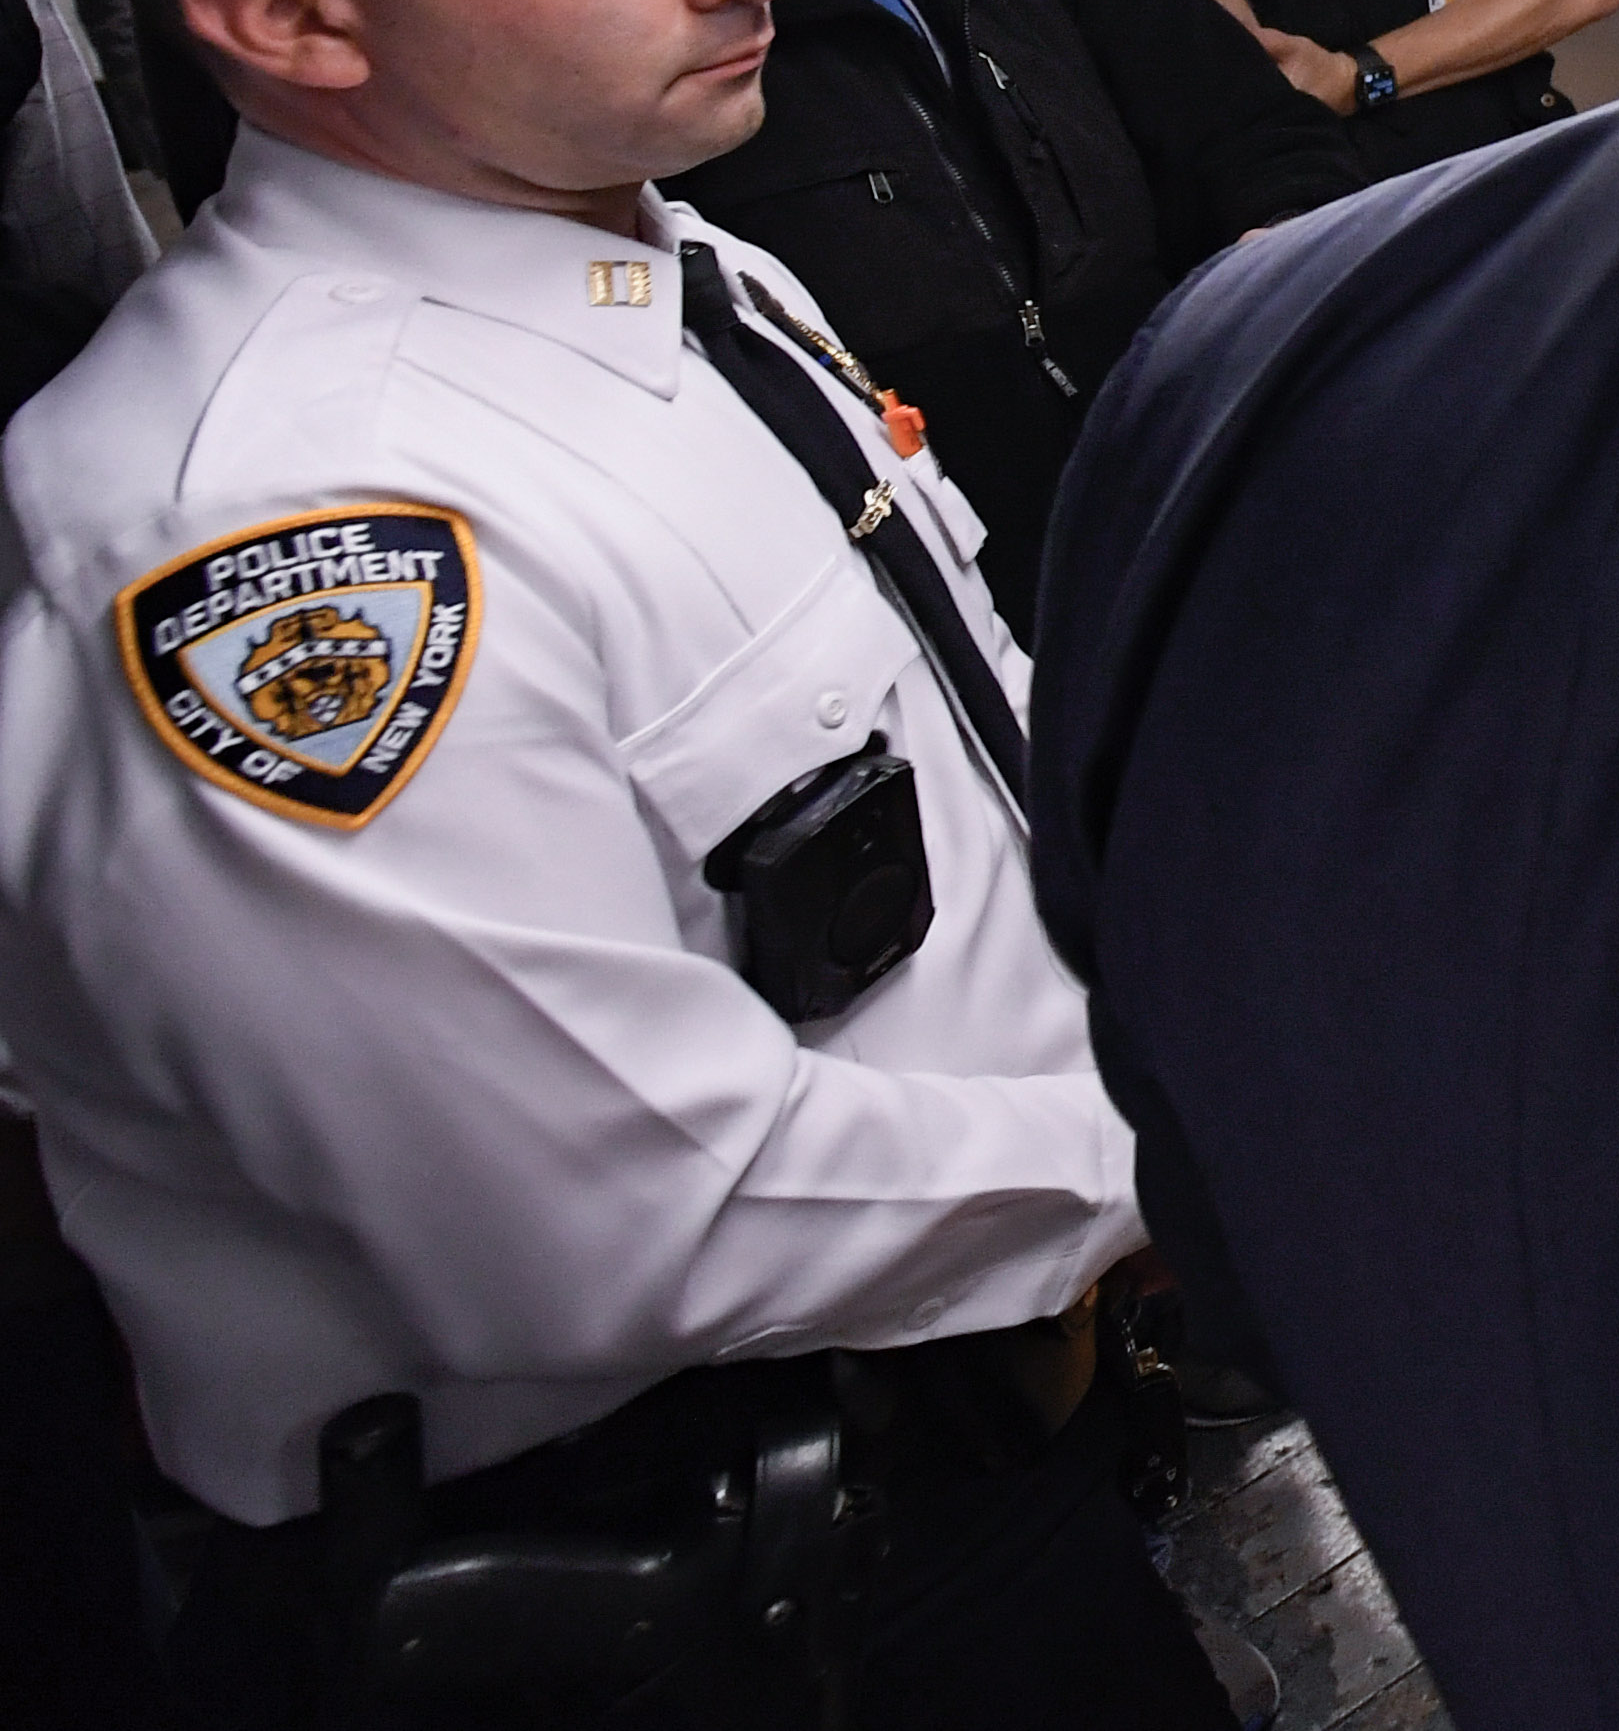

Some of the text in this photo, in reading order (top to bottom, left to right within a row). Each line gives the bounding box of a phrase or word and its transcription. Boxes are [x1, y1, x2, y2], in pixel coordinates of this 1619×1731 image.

[154, 550, 445, 657] DEPARTMENT
[206, 522, 376, 593] POLICE
[165, 689, 306, 785] CITY OF
[360, 602, 466, 774] NEW YORK
